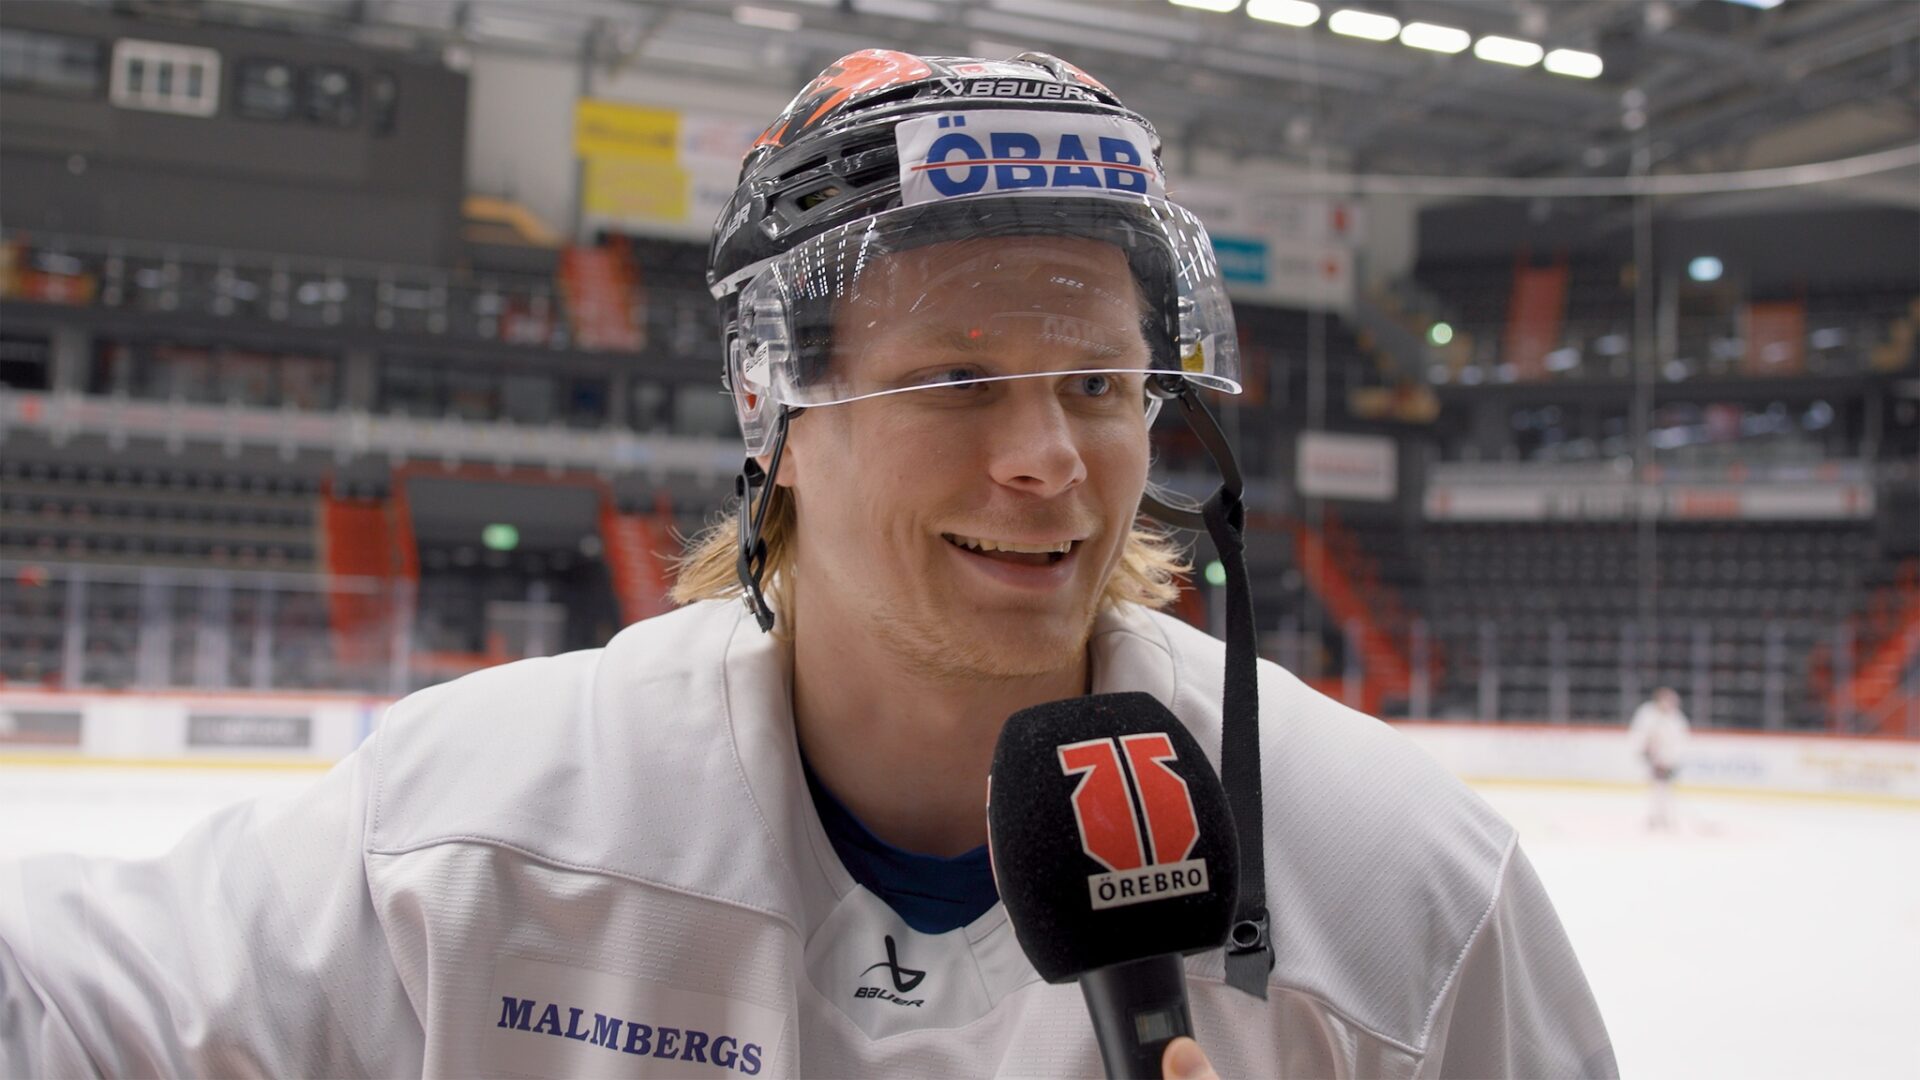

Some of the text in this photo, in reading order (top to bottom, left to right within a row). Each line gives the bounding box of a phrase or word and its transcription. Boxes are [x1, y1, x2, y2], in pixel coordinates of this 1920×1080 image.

[926, 115, 1147, 197] ÖBAB
[1098, 867, 1202, 901] ÖREBRO
[497, 996, 763, 1076] MALMBERGS
